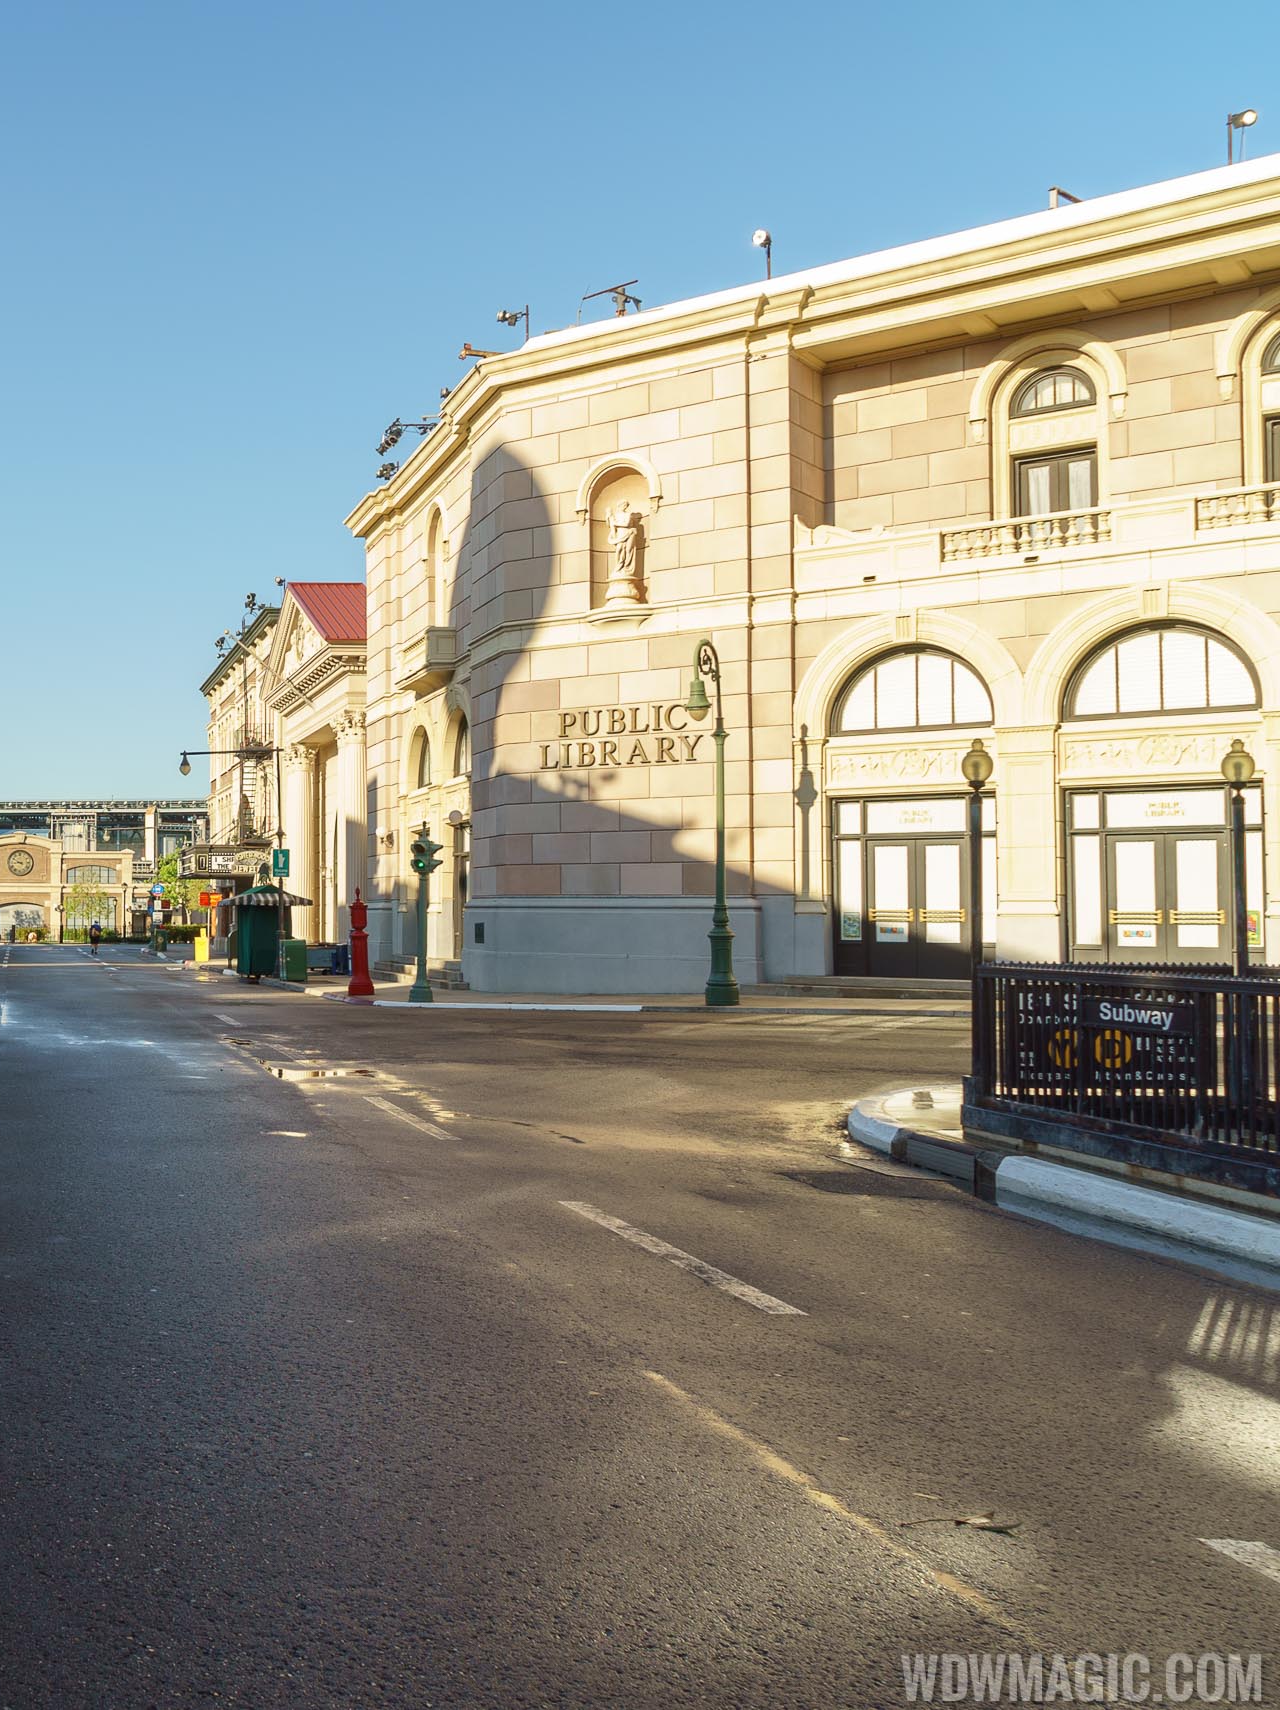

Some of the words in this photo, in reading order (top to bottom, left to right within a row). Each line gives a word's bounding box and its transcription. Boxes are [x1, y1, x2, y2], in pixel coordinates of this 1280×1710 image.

[558, 704, 688, 738] PUBLIC
[539, 735, 704, 770] LIBRARY
[1099, 1001, 1174, 1031] Subway
